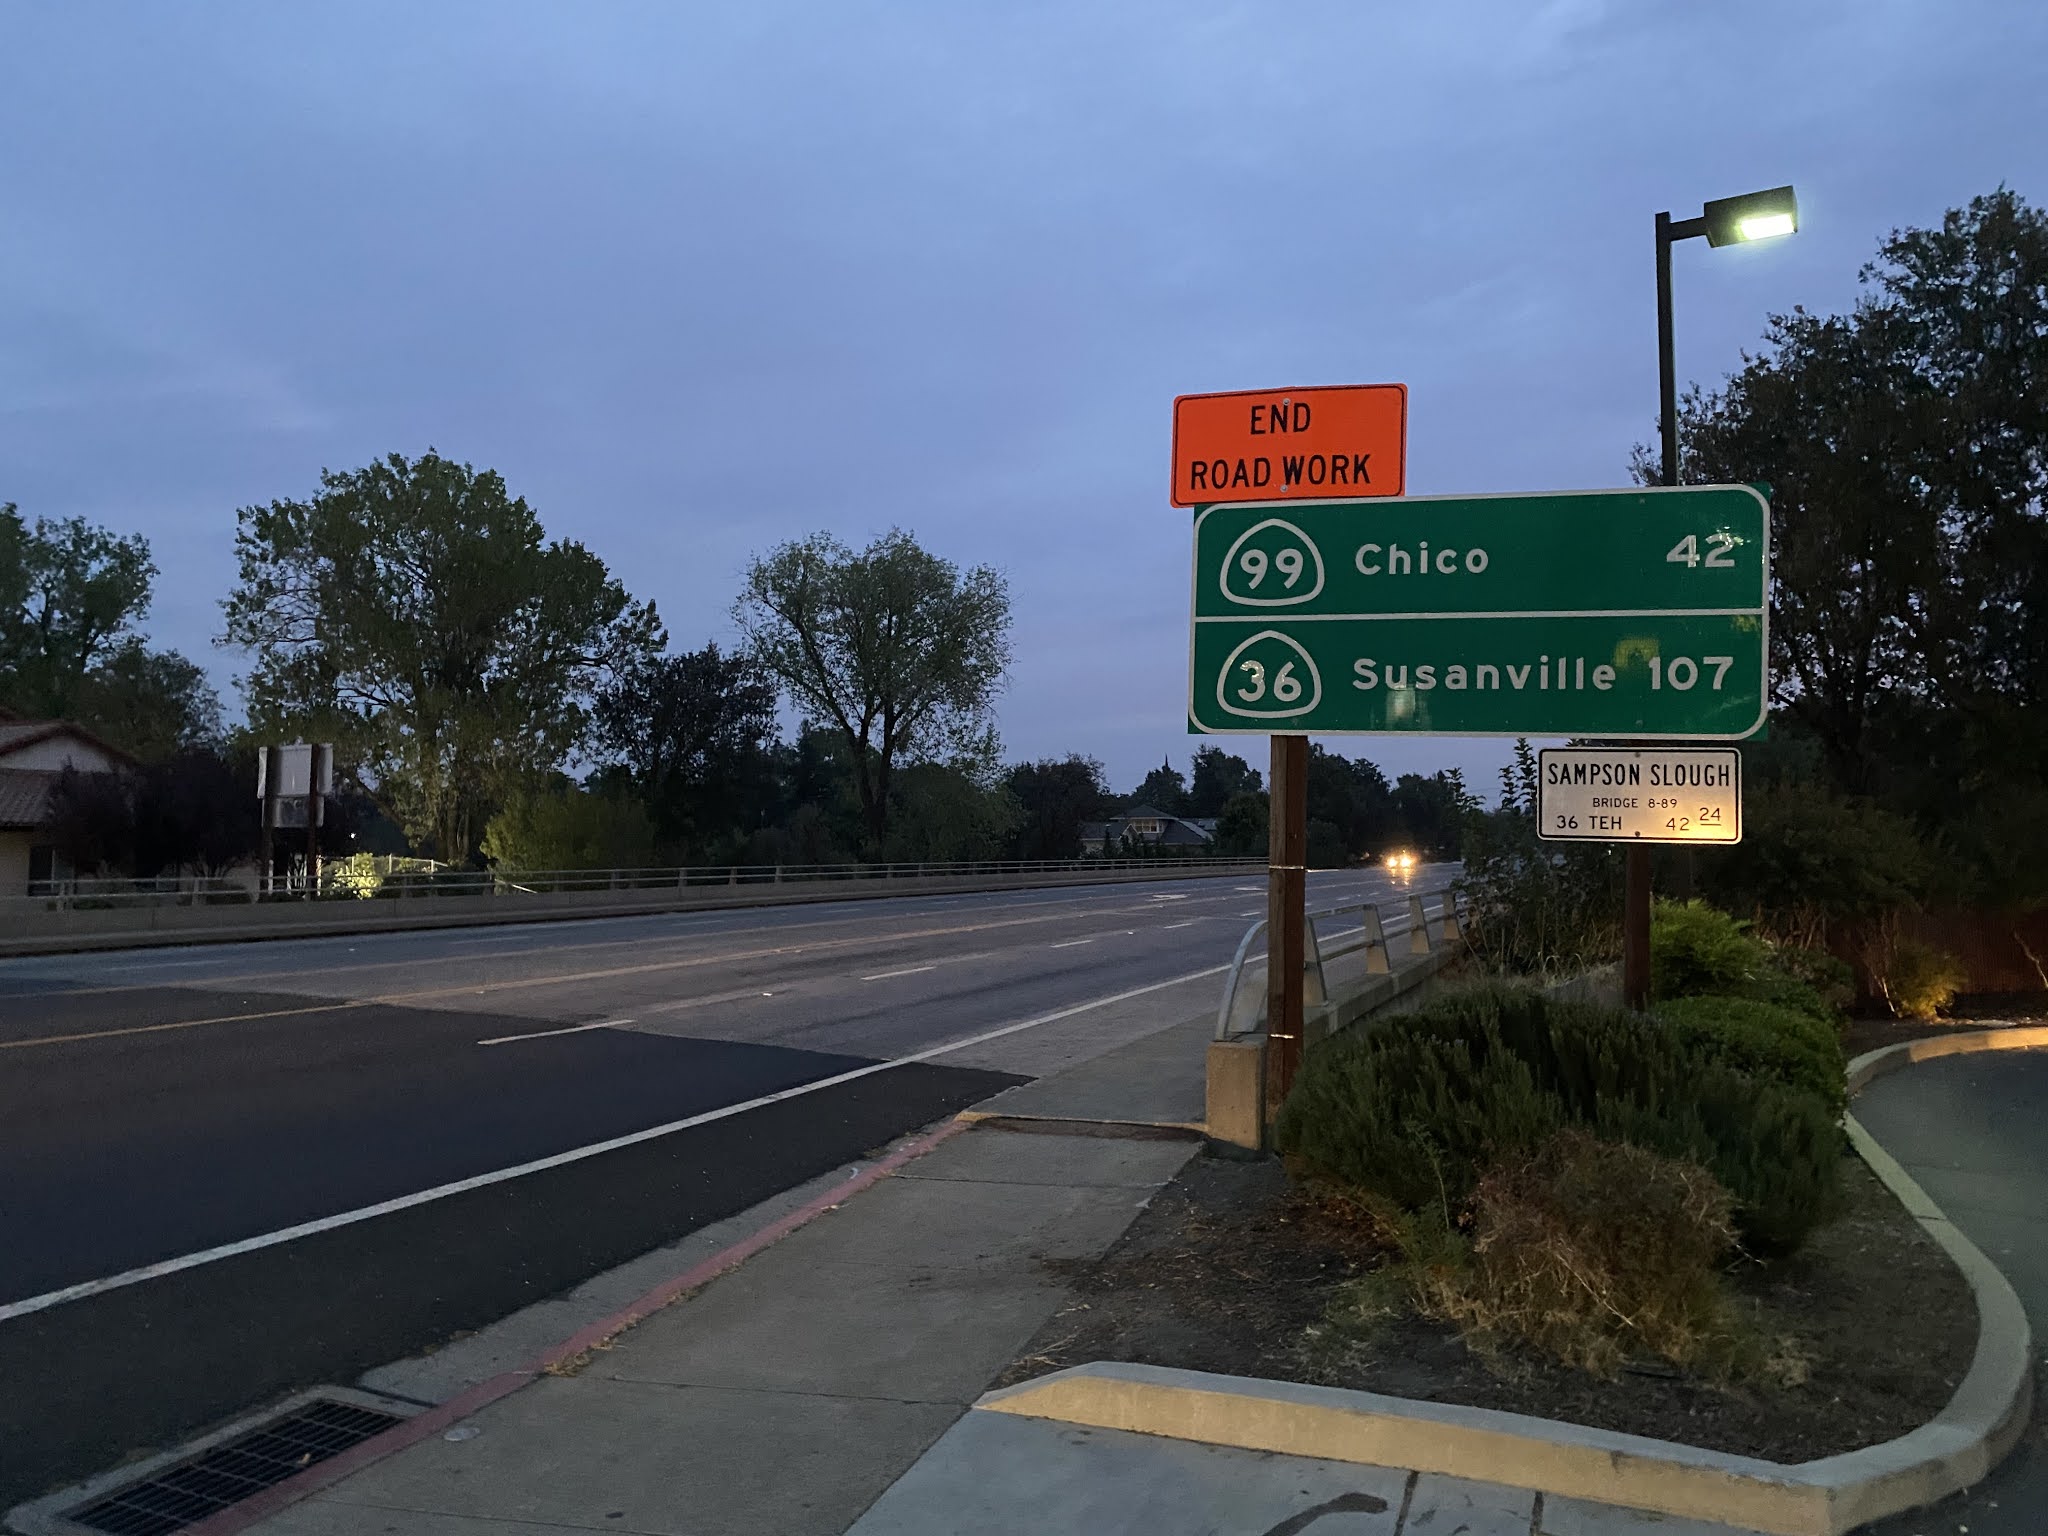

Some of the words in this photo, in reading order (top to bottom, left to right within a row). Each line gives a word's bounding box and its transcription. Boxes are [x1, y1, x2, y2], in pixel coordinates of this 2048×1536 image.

[1250, 402, 1311, 435] END
[1190, 457, 1271, 490] ROAD
[1283, 454, 1371, 485] WORK
[1240, 548, 1304, 590] 99
[1355, 541, 1489, 576] Chico
[1666, 533, 1735, 568] 42
[1237, 660, 1302, 702] 36
[1353, 655, 1616, 691] Susanville
[1649, 656, 1734, 691] 107
[1548, 762, 1640, 786] SAMPSON
[1650, 763, 1729, 787] SLOUGH
[1556, 815, 1578, 829] 36
[1589, 816, 1622, 830] TEH
[1666, 817, 1690, 831] 42
[1699, 807, 1721, 821] 24
[1592, 797, 1639, 808] BRIDGE
[1648, 798, 1678, 808] 8-89
